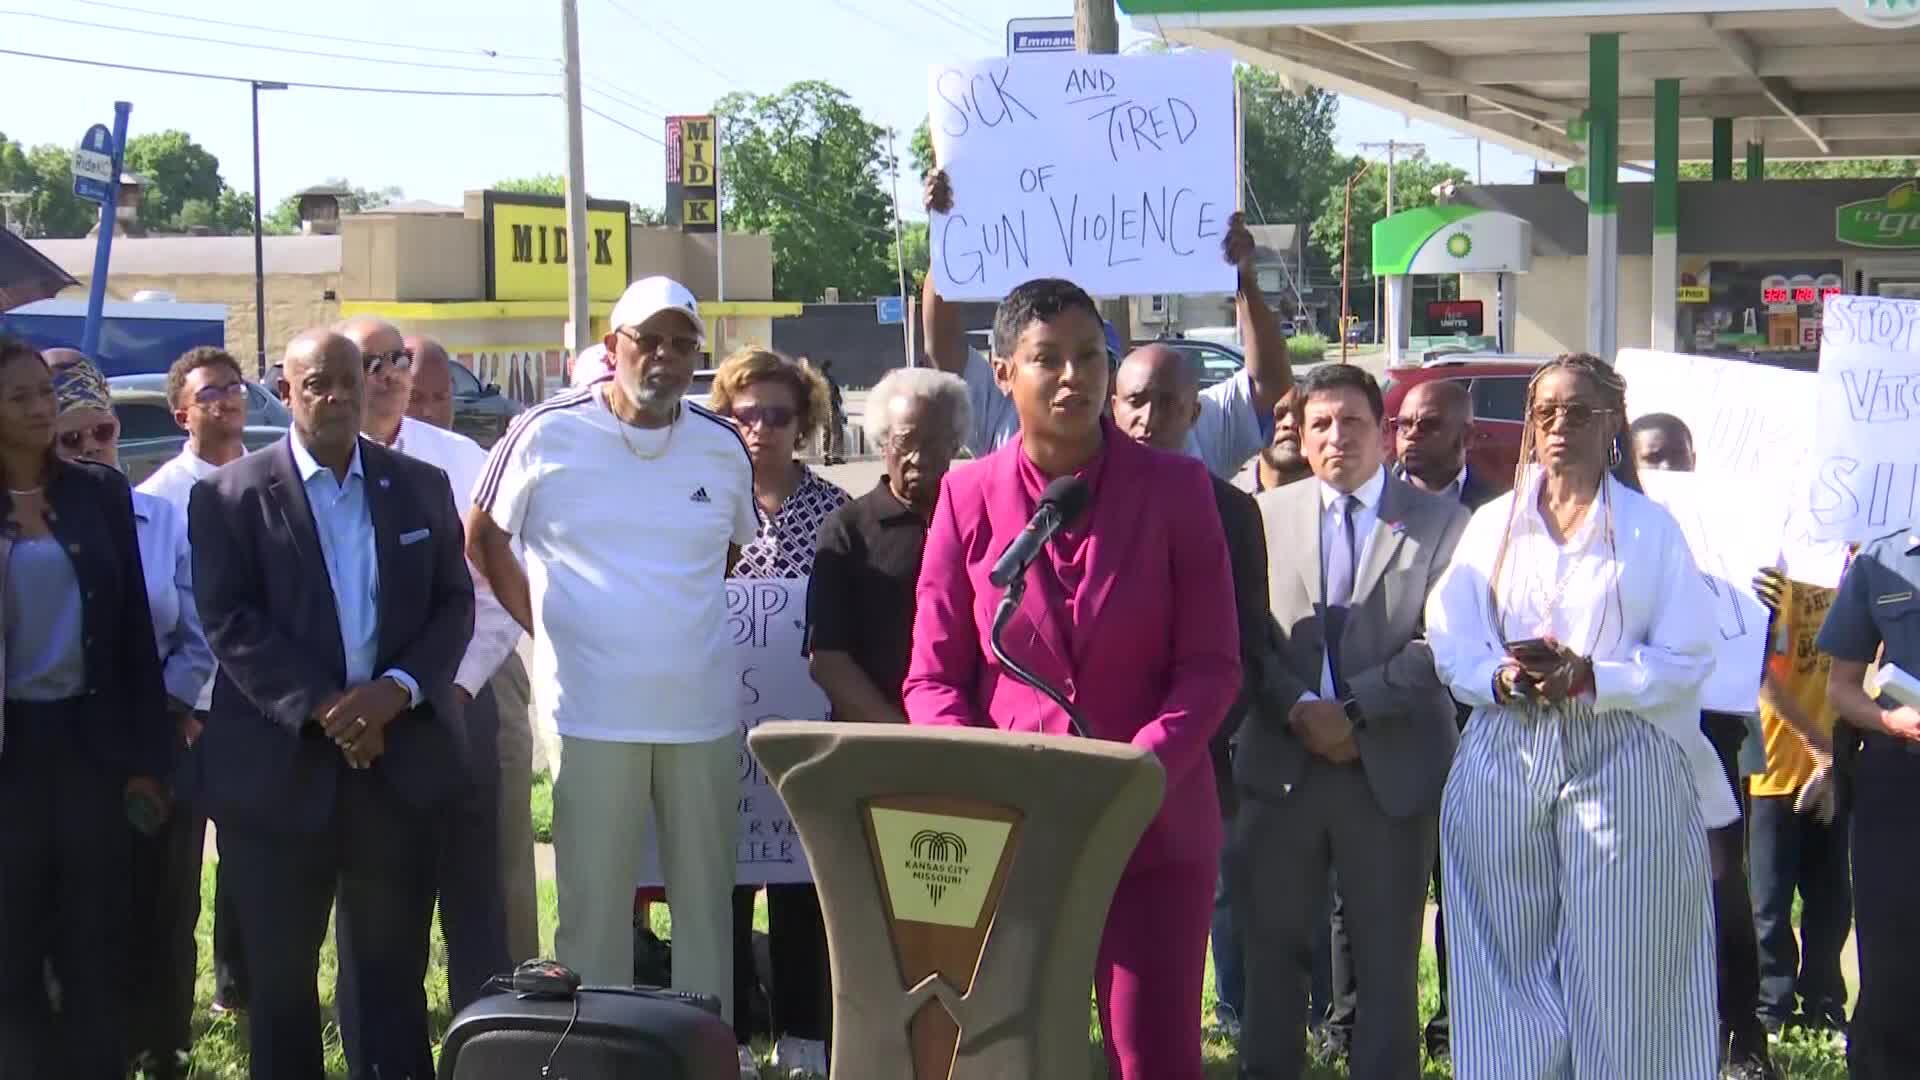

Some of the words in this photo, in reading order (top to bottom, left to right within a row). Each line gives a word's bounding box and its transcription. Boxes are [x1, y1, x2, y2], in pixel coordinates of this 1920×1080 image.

[937, 65, 1038, 136] SICK
[1065, 68, 1116, 93] AND
[1087, 97, 1198, 161] TIRED
[686, 121, 709, 183] MID
[1019, 164, 1056, 193] OF
[689, 202, 709, 221] K
[943, 210, 1029, 284] GUN
[1049, 185, 1219, 267] VIOLENCE
[905, 860, 944, 872] KANSAS
[947, 863, 970, 875] CITY
[913, 871, 962, 885] MISSOURI
